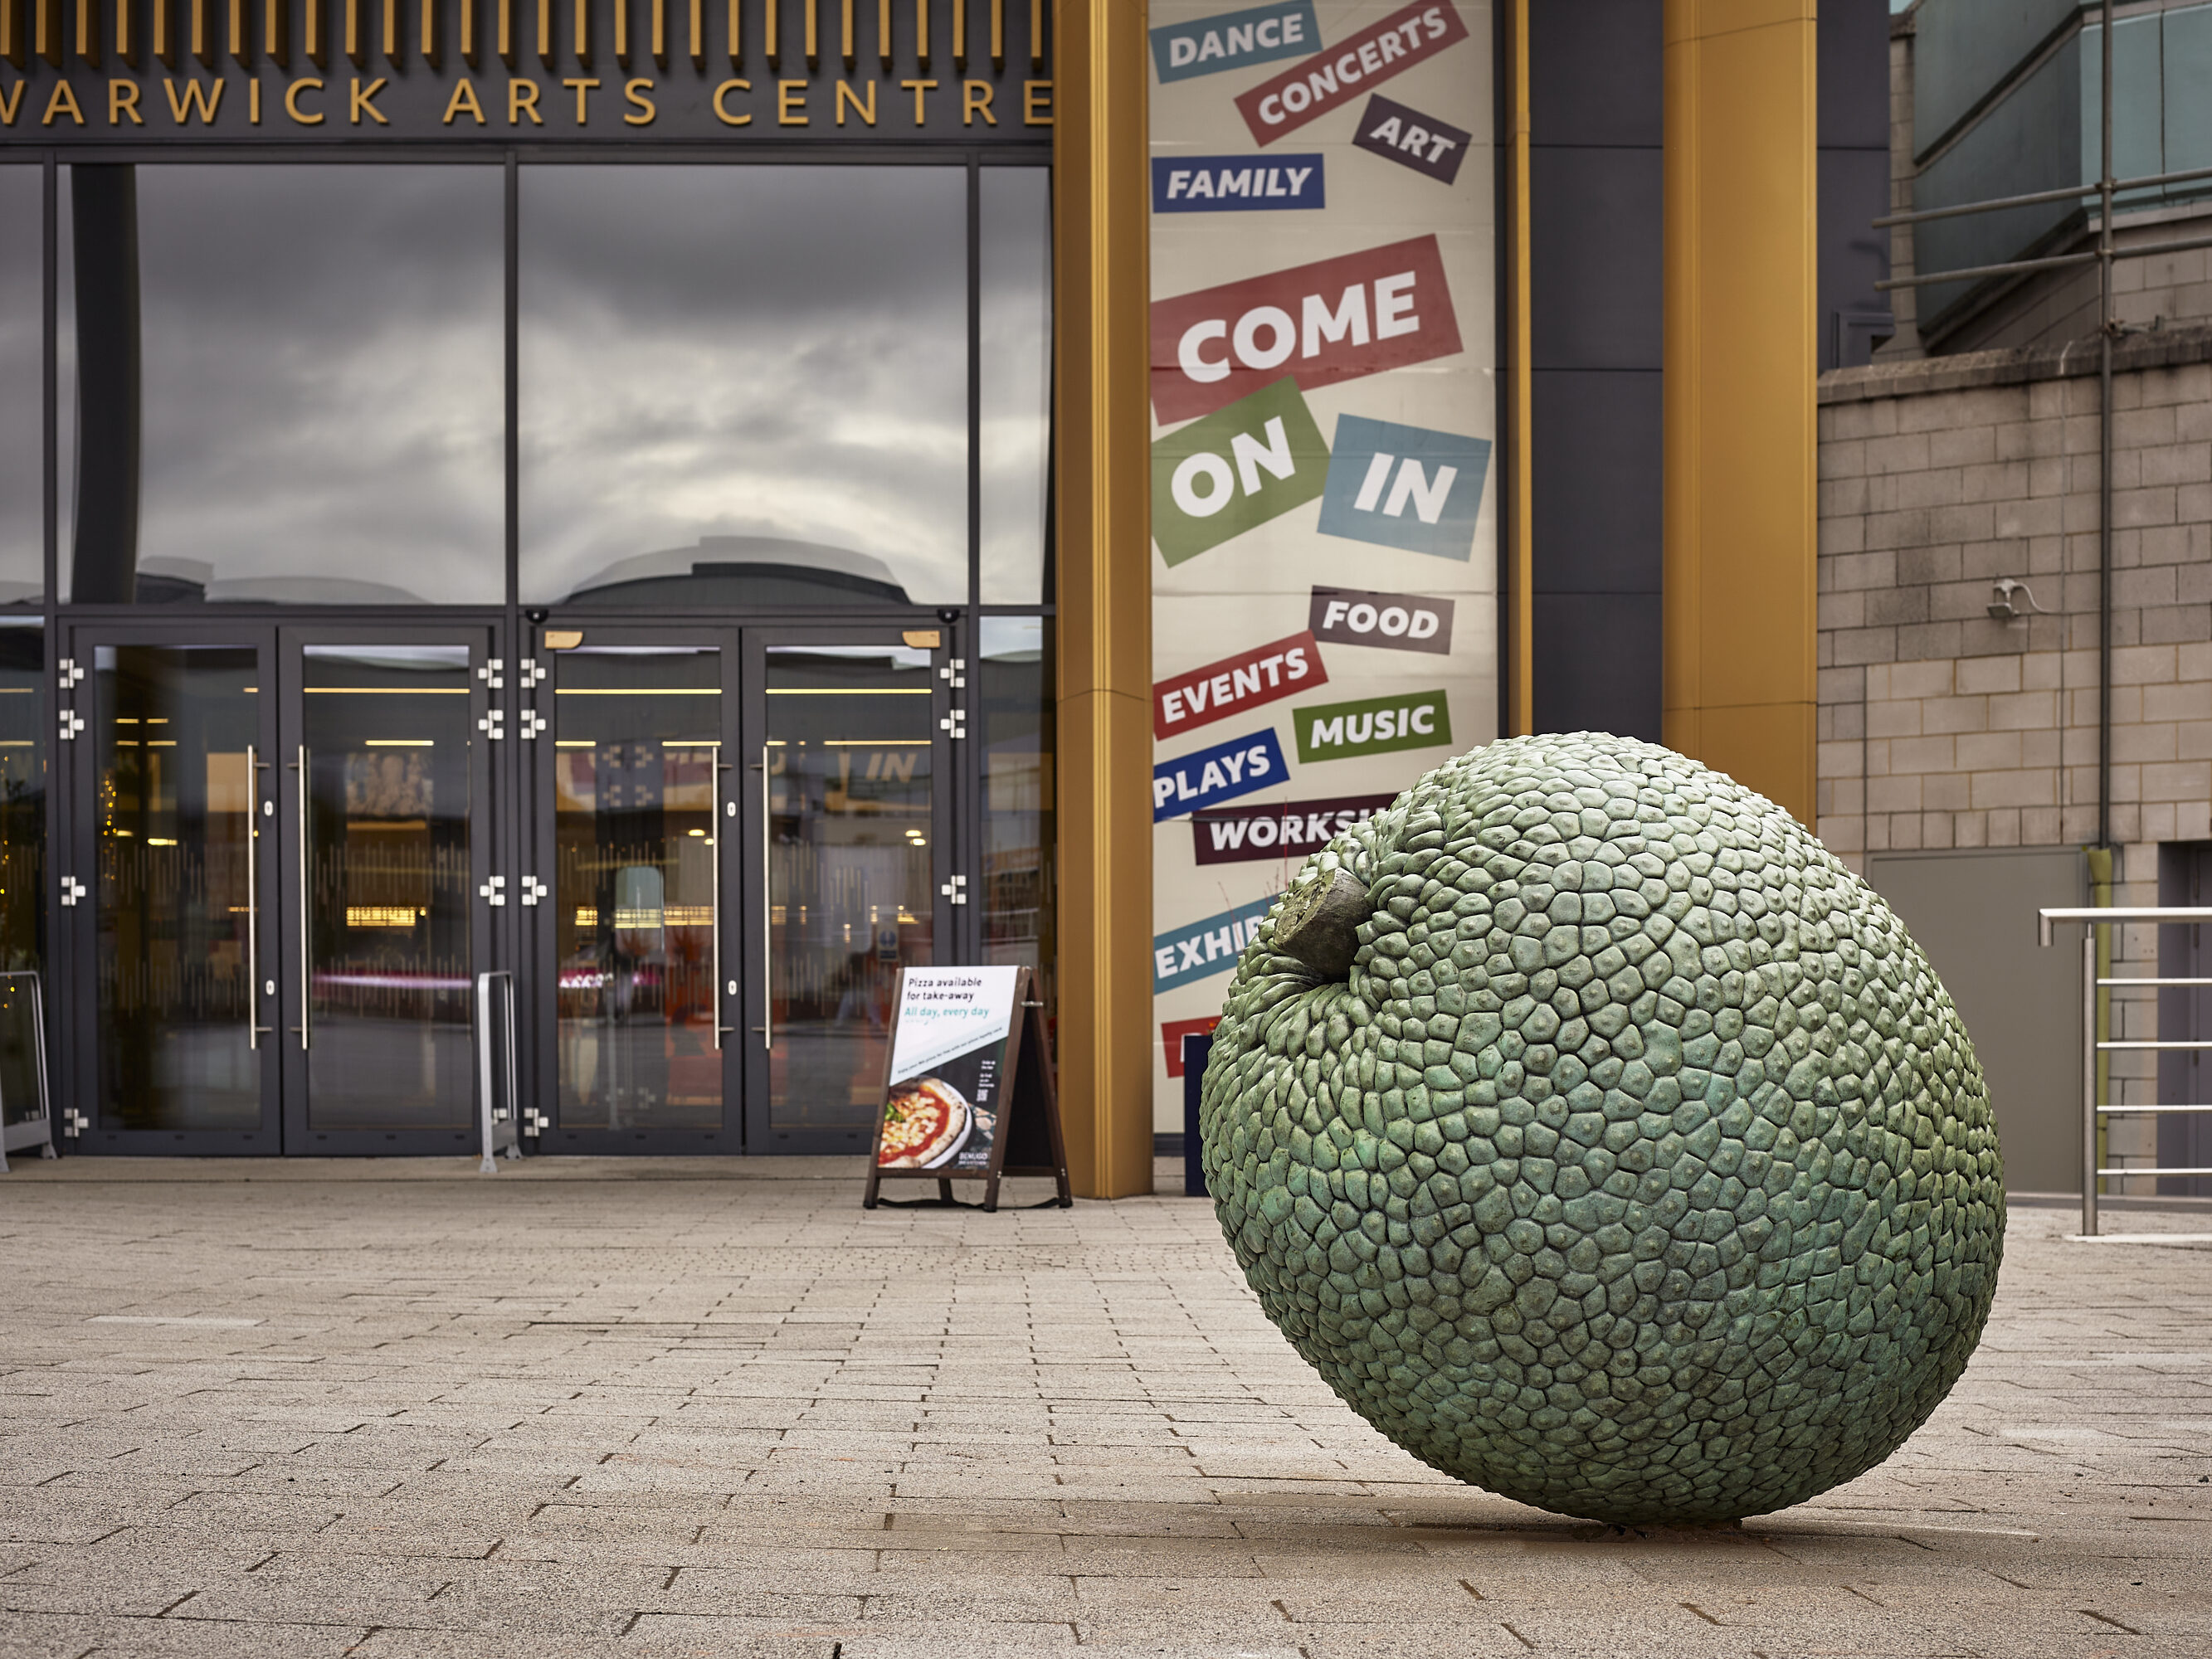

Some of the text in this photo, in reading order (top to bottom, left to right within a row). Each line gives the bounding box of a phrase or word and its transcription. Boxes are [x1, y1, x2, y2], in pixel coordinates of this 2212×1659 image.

[1169, 12, 1304, 68] DANCE
[1258, 7, 1449, 125] CONCERTS
[442, 77, 656, 125] ARTS
[712, 78, 1054, 125] CENTRE
[1368, 115, 1456, 164] ART
[1166, 166, 1313, 200] FAMILY
[1177, 270, 1420, 383] COME
[1171, 416, 1297, 518] ON
[1353, 451, 1459, 525] IN
[1322, 600, 1440, 640] FOOD
[1162, 647, 1309, 724] EVENTS
[1310, 704, 1435, 749] MUSIC
[1153, 745, 1271, 809] PLAYS
[907, 991, 974, 1003] for take-away
[909, 977, 982, 987] Pizza available
[904, 1006, 990, 1019] All day, every day
